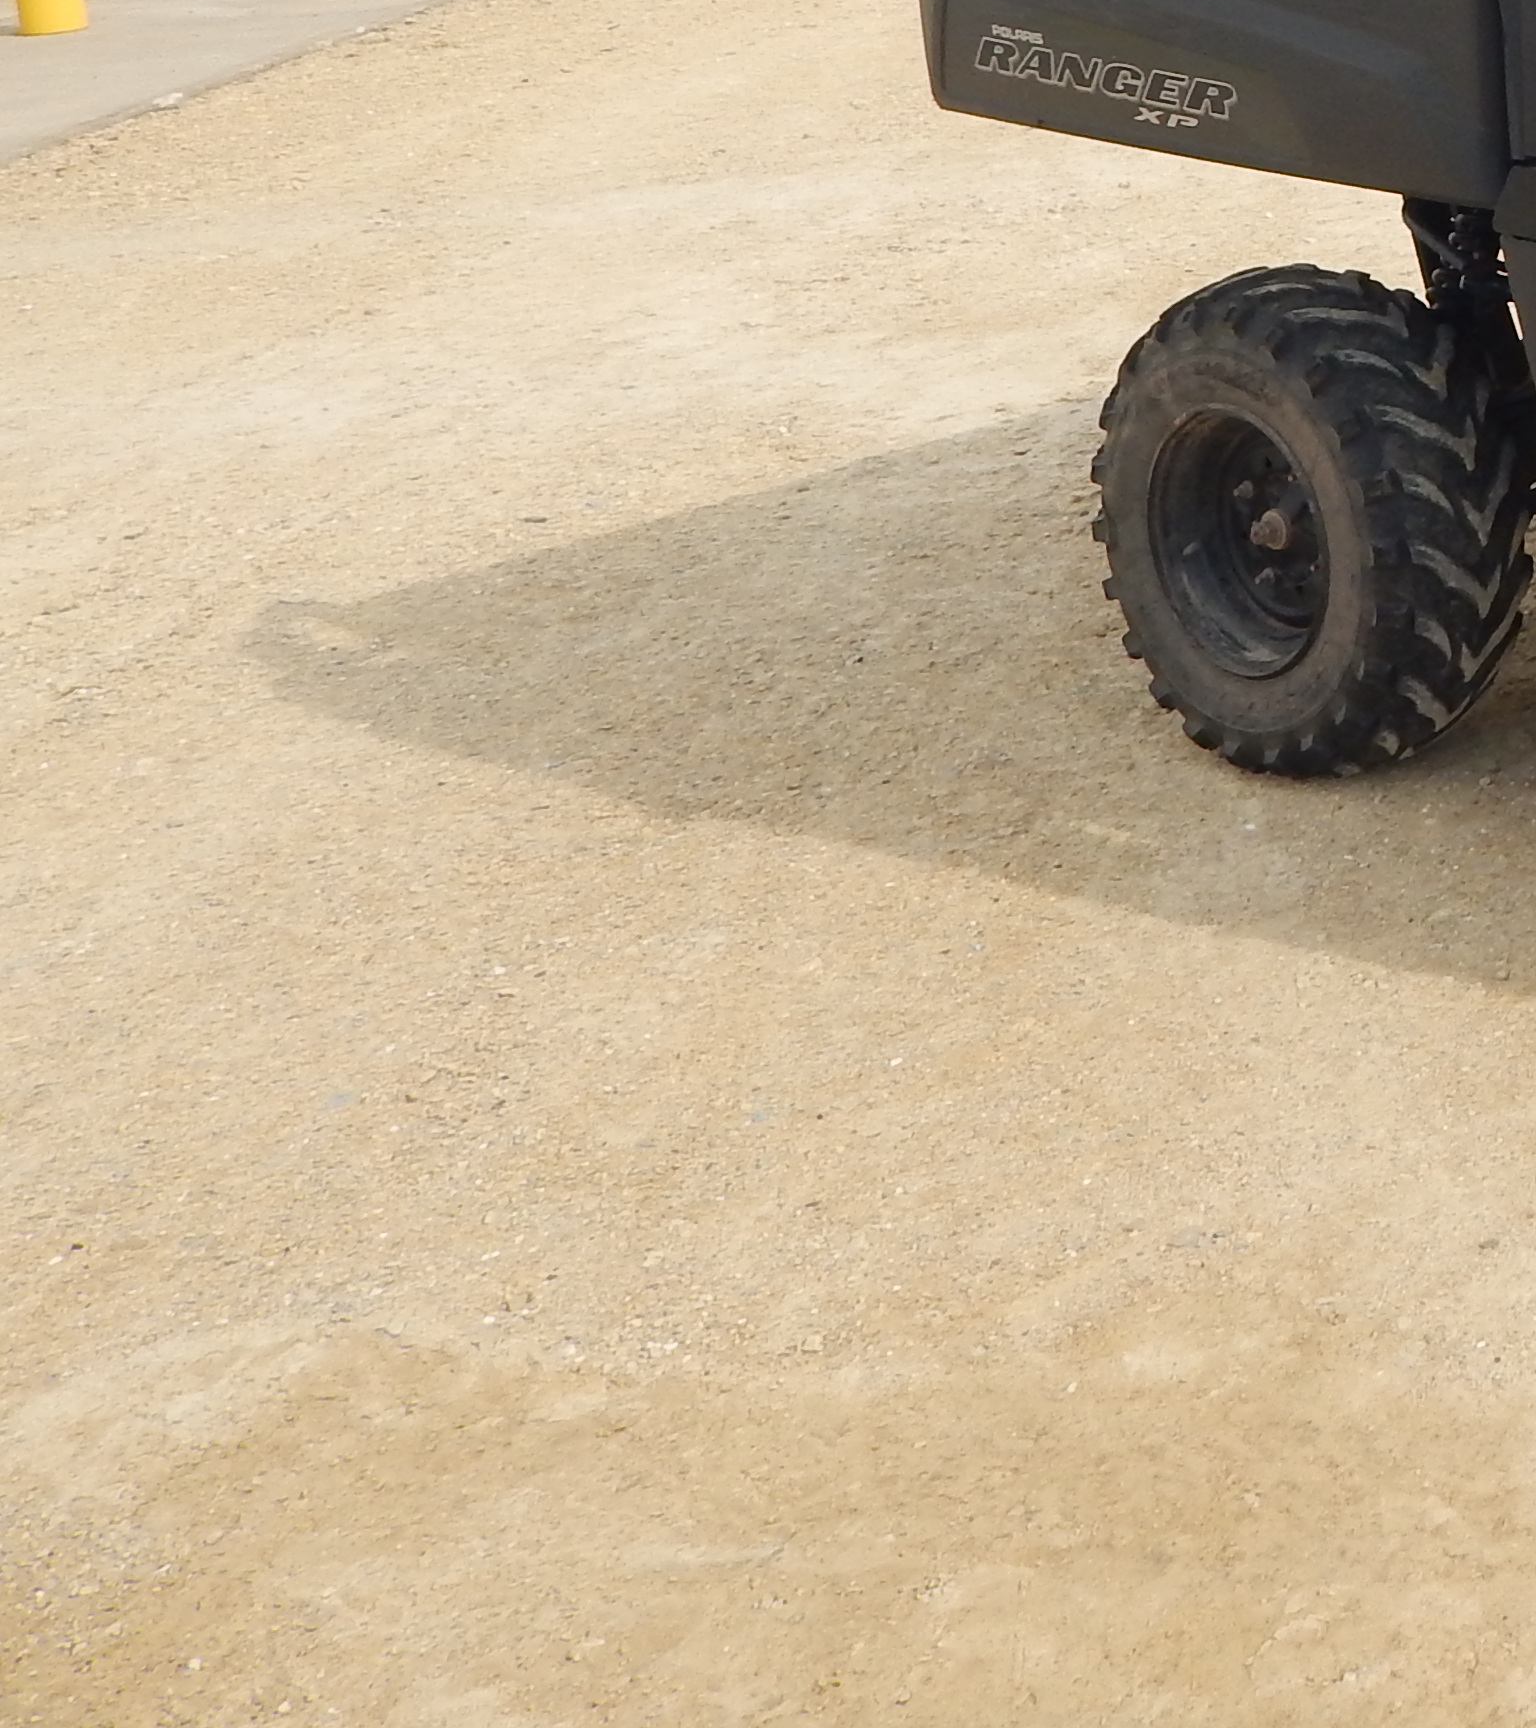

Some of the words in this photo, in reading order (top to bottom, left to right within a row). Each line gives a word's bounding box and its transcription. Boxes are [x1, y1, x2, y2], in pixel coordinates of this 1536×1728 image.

[991, 23, 1044, 45] POLARIS
[974, 36, 1239, 121] RANGER
[1133, 106, 1200, 129] XP
